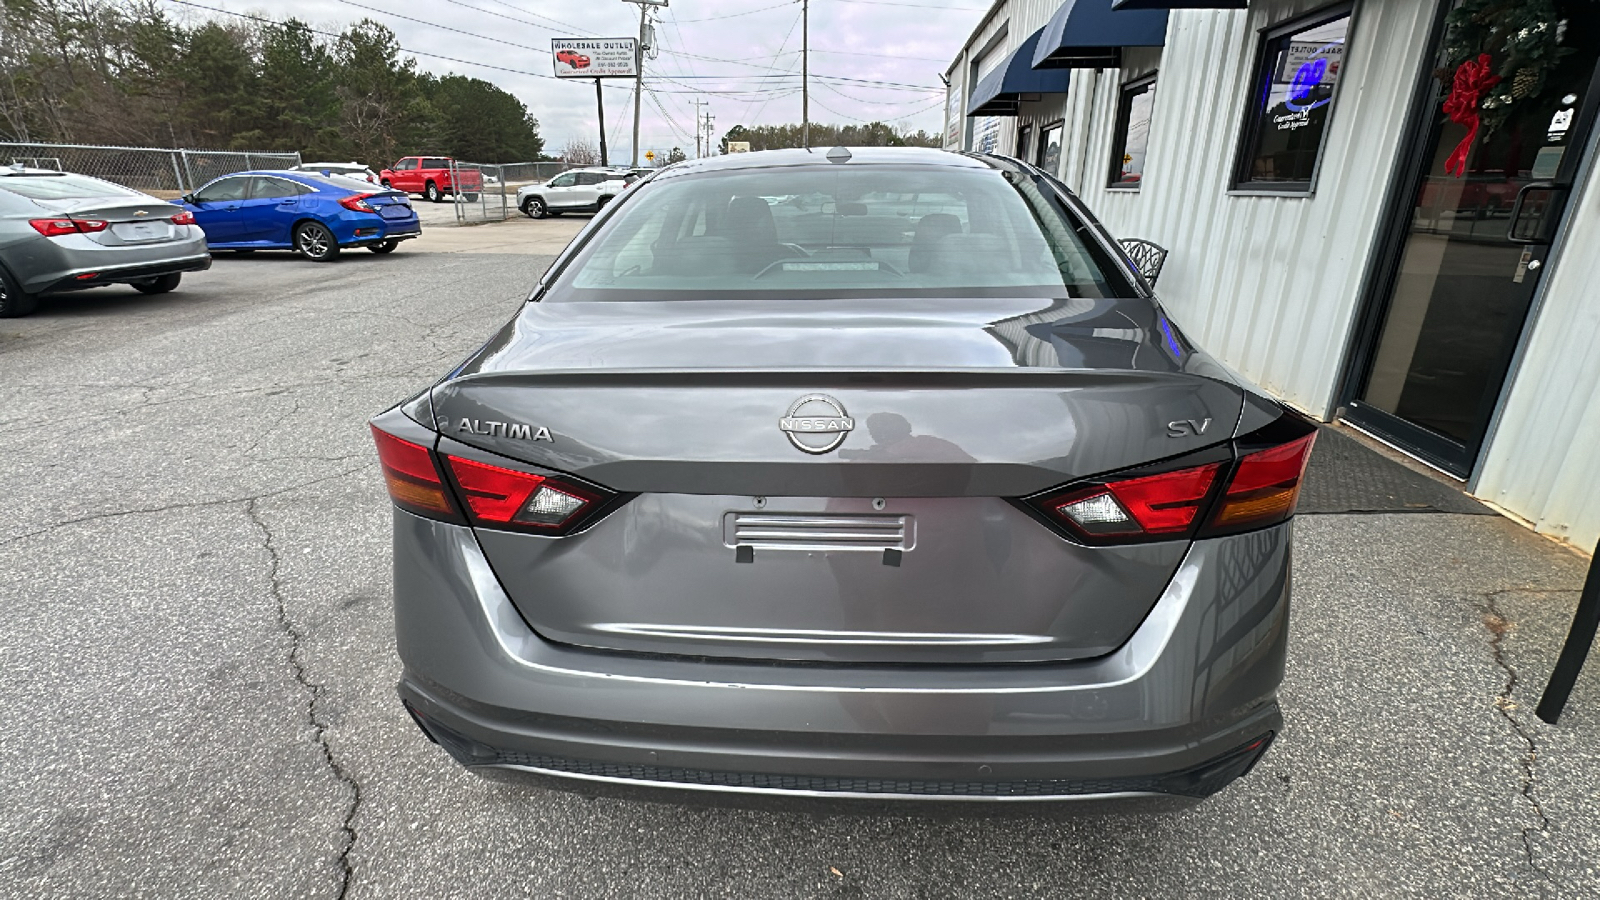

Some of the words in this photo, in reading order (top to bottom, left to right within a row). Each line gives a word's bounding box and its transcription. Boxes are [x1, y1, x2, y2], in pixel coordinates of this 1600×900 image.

[1277, 121, 1290, 130] Credit
[457, 416, 554, 444] ALTIMA
[780, 417, 855, 431] NISSAN
[1167, 417, 1212, 438] SV
